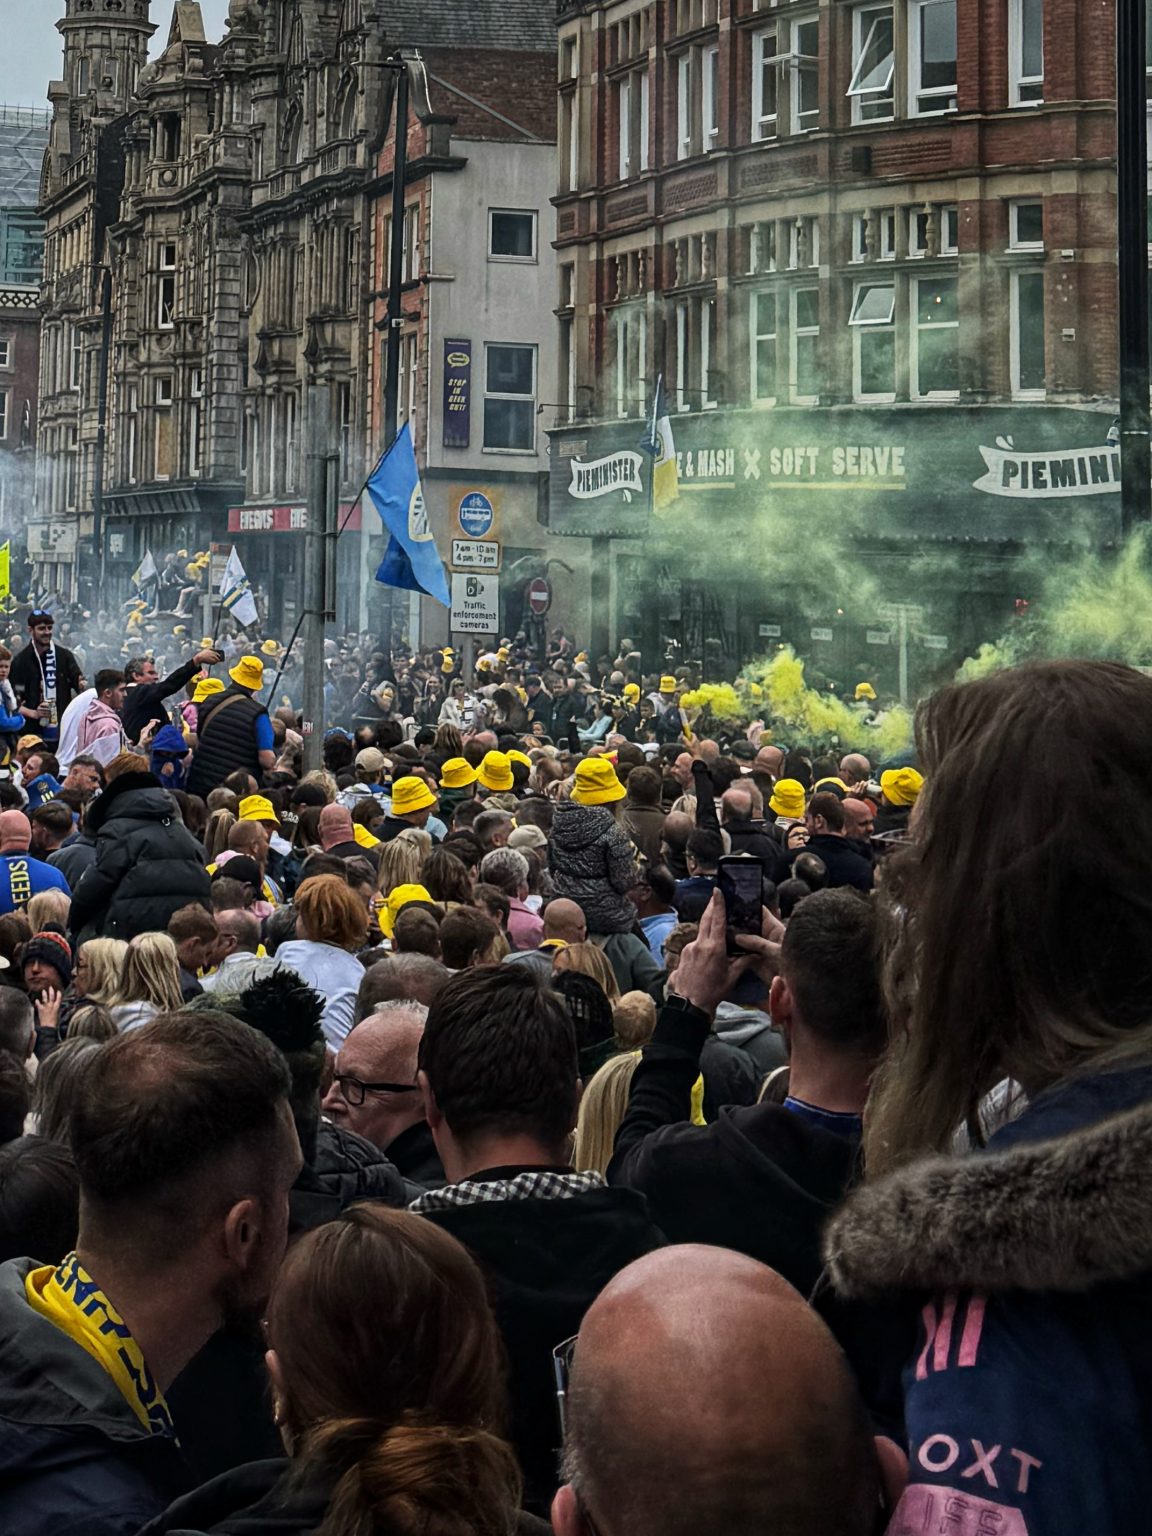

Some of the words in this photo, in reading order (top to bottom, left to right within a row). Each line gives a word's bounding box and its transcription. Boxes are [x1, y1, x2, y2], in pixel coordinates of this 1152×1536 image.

[577, 457, 636, 492] PIEMINISTER
[697, 448, 735, 478] MASH
[769, 447, 820, 476] SOFT
[832, 446, 906, 477] SERVE
[453, 611, 497, 620] enforcement
[463, 601, 487, 610] Traffic
[459, 621, 490, 629] cameras
[9, 860, 31, 904] EEDS
[918, 1433, 1043, 1494] OXT
